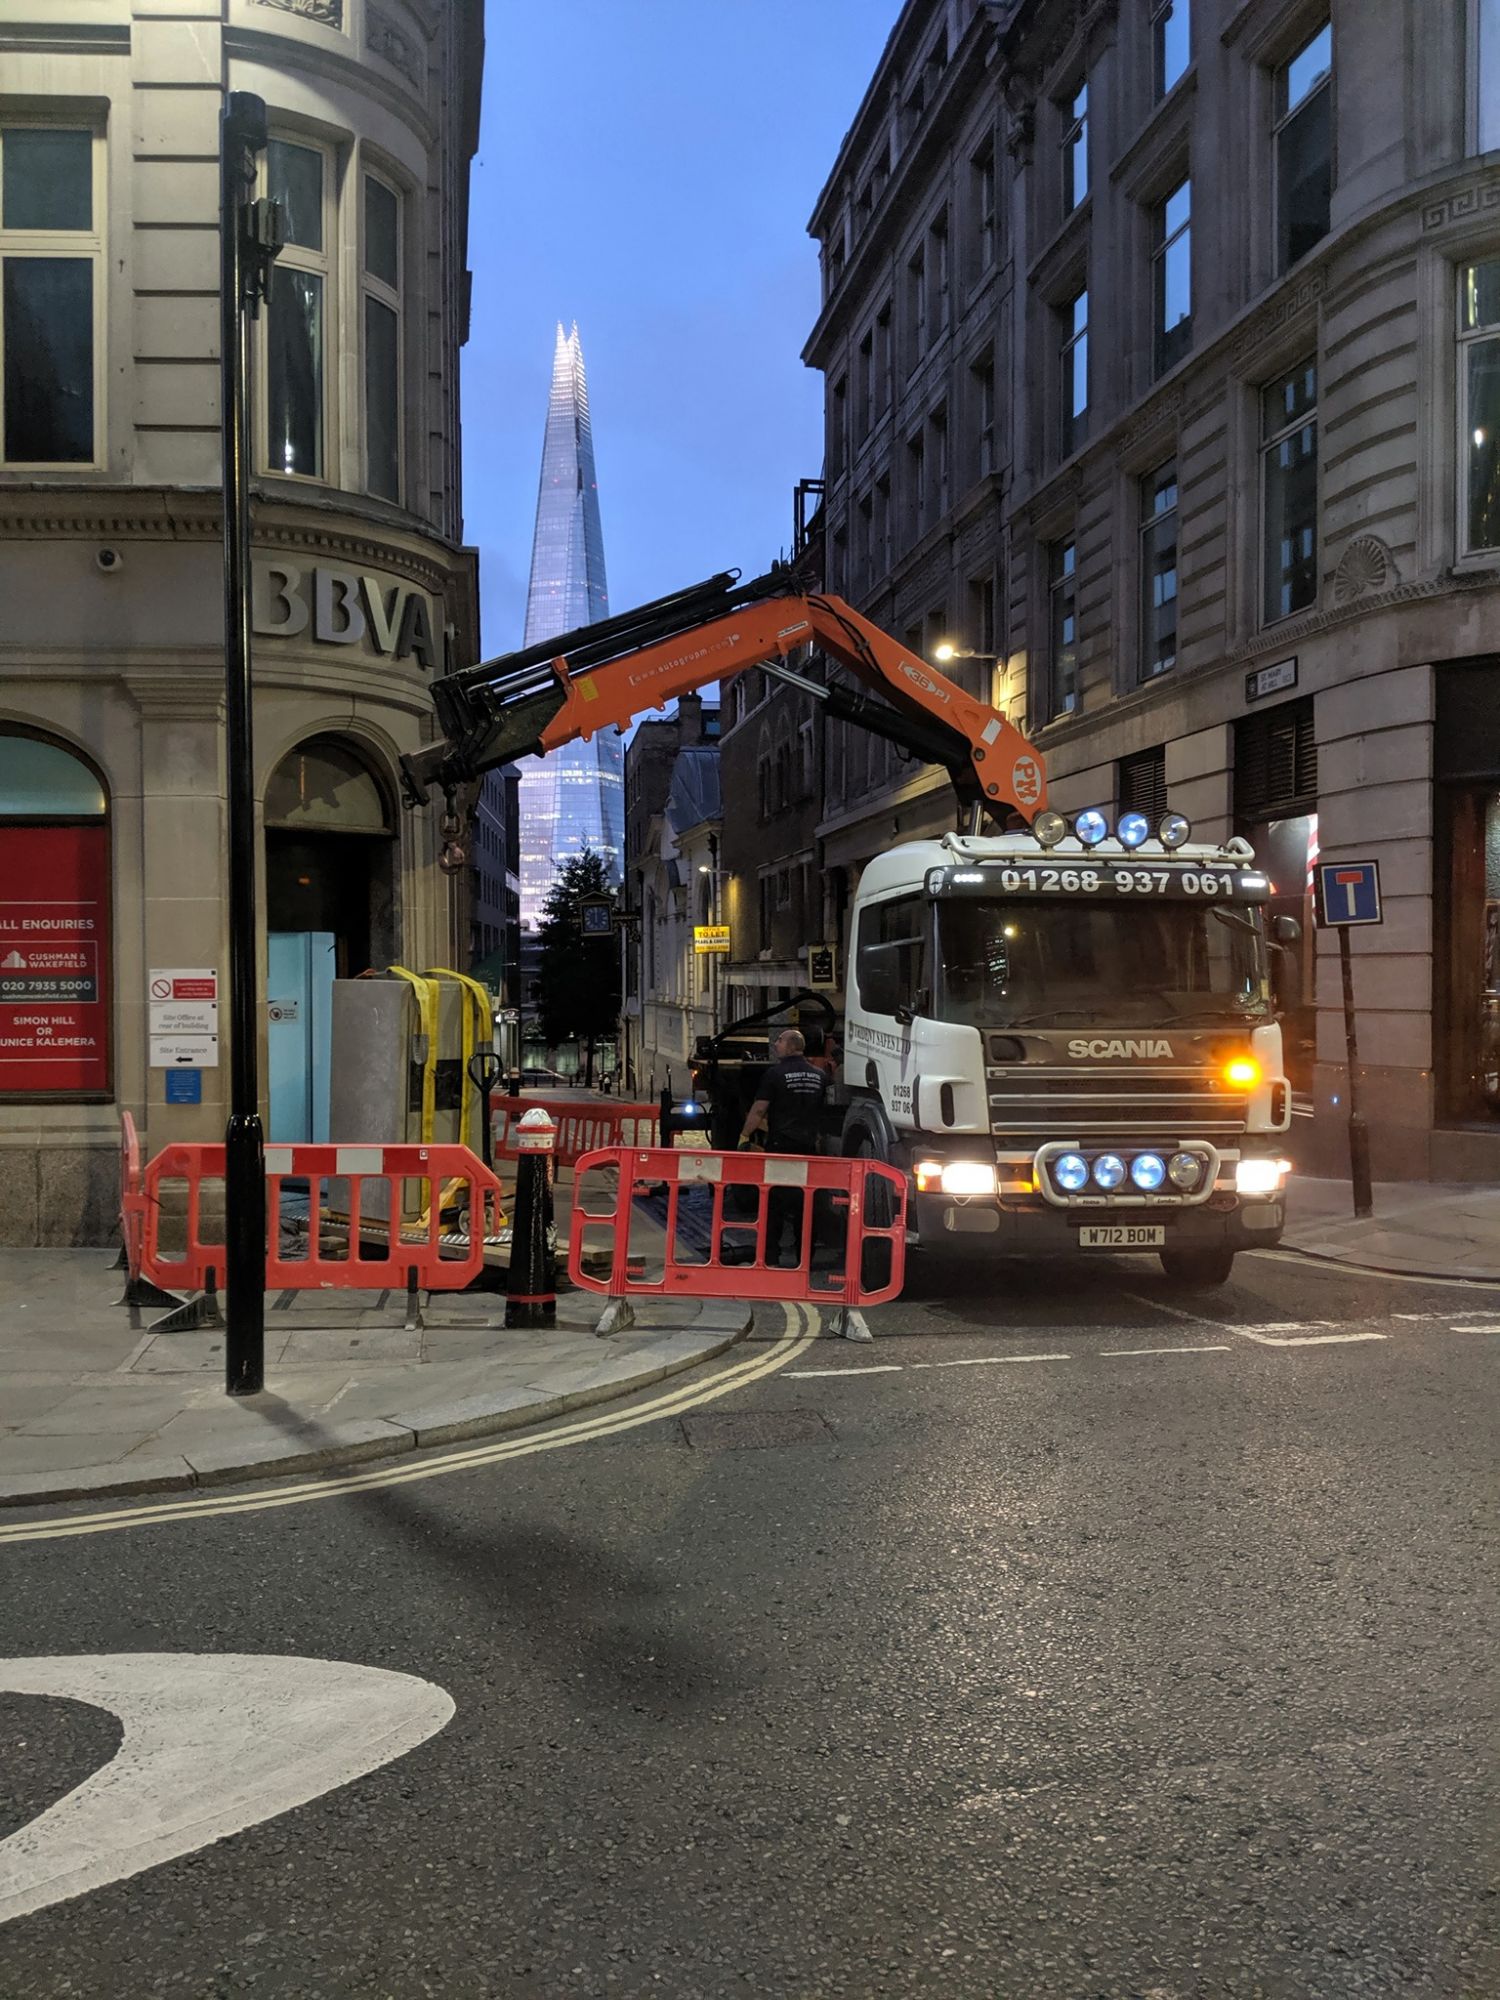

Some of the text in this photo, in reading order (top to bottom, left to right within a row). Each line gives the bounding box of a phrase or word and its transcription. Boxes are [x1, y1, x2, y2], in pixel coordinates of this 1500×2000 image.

[251, 559, 436, 668] BBVA
[1015, 761, 1038, 799] PM
[1001, 869, 1233, 895] 01268 937 061
[0, 919, 95, 930] LL ENQUIRIES
[28, 953, 77, 961] CUSHMAN
[2, 981, 91, 991] 020 7935 5000
[13, 1016, 75, 1025] SIMON HILL
[36, 1027, 53, 1036] OR
[182, 1022, 209, 1031] building
[0, 1037, 96, 1047] UNICE KALEMERA
[876, 1030, 896, 1051] SAFES
[175, 1047, 208, 1055] Entrance
[1068, 1040, 1174, 1058] SCANIA
[893, 1084, 911, 1098] 01268
[891, 1100, 902, 1112] 937
[1089, 1228, 1156, 1243] W712 BOM
